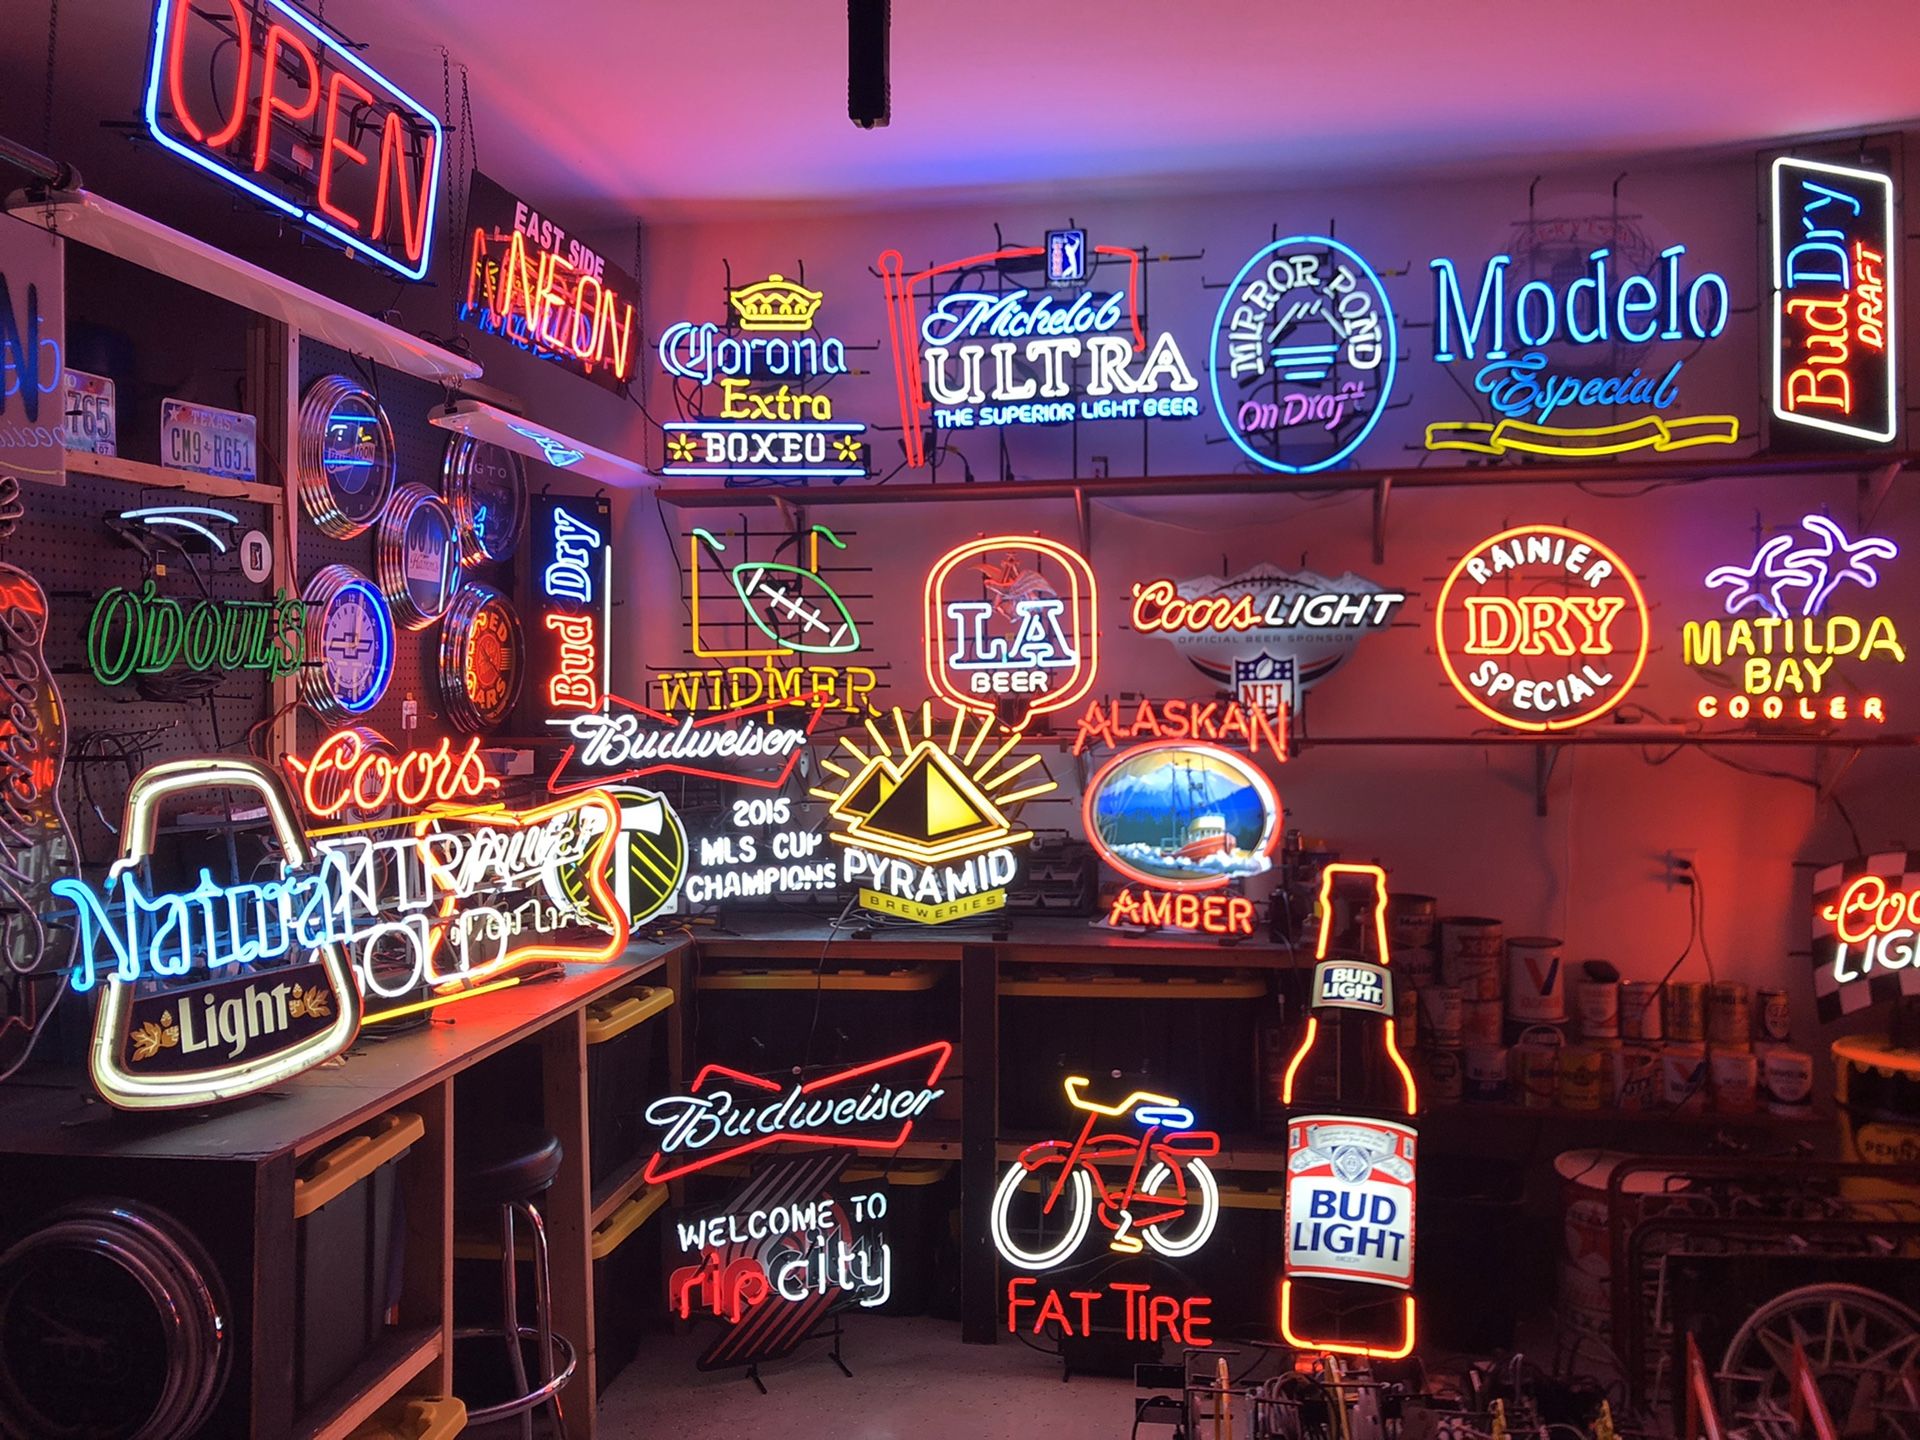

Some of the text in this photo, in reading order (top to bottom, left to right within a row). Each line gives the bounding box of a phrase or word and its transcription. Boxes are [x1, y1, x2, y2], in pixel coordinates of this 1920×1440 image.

[168, 0, 436, 262] OPEN
[513, 200, 606, 285] EAST SIDE
[500, 230, 633, 379] NEON
[921, 288, 1125, 346] Michelob
[1227, 253, 1383, 379] MIRROR POND
[1429, 244, 1729, 363] Modelo
[1784, 180, 1862, 415] Bud Dry
[1854, 241, 1886, 350] DRAFT
[658, 321, 848, 386] Corona
[924, 331, 1199, 405] ULTRA
[719, 377, 833, 421] Extra
[933, 396, 1200, 429] THE SUPERIOR LIGHT BEER
[1474, 352, 1684, 425] Especial
[191, 410, 232, 432] TEXAS
[1238, 401, 1280, 432] On
[213, 434, 251, 473] R651
[474, 462, 507, 479] GTO
[1465, 535, 1613, 588] RAINIER
[544, 506, 601, 710] Bud Dry
[1132, 579, 1405, 631] Coors LIGHT
[1463, 596, 1626, 656] DRY
[946, 598, 1081, 670] LA
[1177, 633, 1354, 645] OFFICIAL BEER SPONSOR
[1682, 615, 1906, 666] MATILDA
[656, 665, 883, 718] WIDMER
[970, 670, 1049, 693] BEER
[1241, 683, 1285, 706] NFL
[1469, 659, 1614, 712] SPECIAL
[1743, 656, 1834, 695] BAY
[1072, 699, 1289, 763] ALASKAN
[1697, 695, 1887, 724] COOLER
[569, 713, 807, 767] Budweiser
[286, 730, 500, 816] Coors
[732, 797, 791, 828] 2015
[699, 831, 823, 867] MLS CUP
[843, 847, 1018, 904] PYRAMID
[685, 862, 837, 904] CHAMPIONS
[870, 894, 997, 920] BREWERIES
[51, 850, 358, 992] Natural
[1108, 887, 1254, 934] AMBER
[308, 904, 510, 999] OLD
[1331, 967, 1378, 986] BUD
[1321, 981, 1384, 1004] LIGHT
[177, 982, 291, 1059] Light
[644, 1082, 945, 1154] Budweiser
[676, 1192, 888, 1252] WELCOME TO
[1309, 1189, 1397, 1226] BUD
[1292, 1221, 1406, 1262] LIGHT
[678, 1235, 893, 1324] rip city
[1007, 1277, 1214, 1347] FAT TIRE
